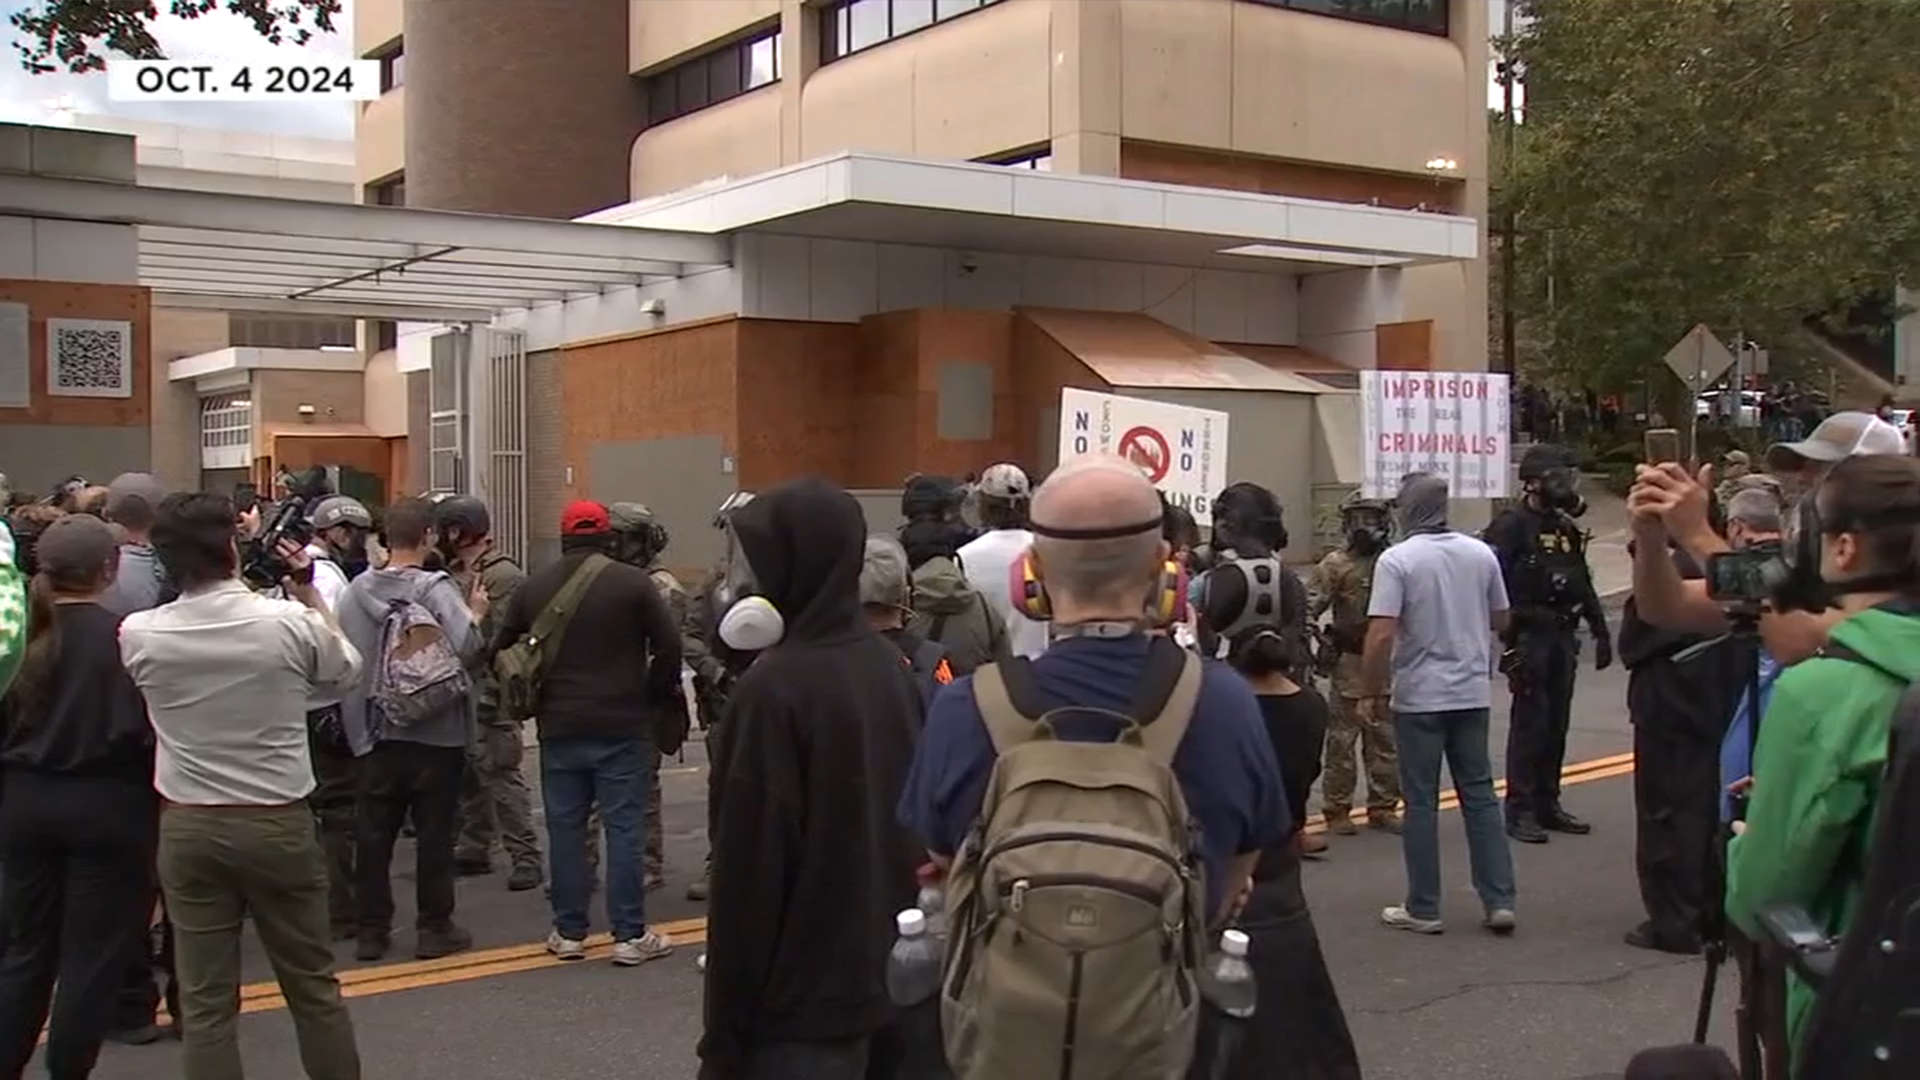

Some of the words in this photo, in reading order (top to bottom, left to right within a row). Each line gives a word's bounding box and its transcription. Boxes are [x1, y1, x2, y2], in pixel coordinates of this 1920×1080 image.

[1384, 379, 1489, 400] IMPRISON
[1396, 407, 1416, 419] THE
[1075, 411, 1089, 454] NO
[1180, 430, 1194, 471] NO
[1378, 433, 1498, 455] CRIMINALS
